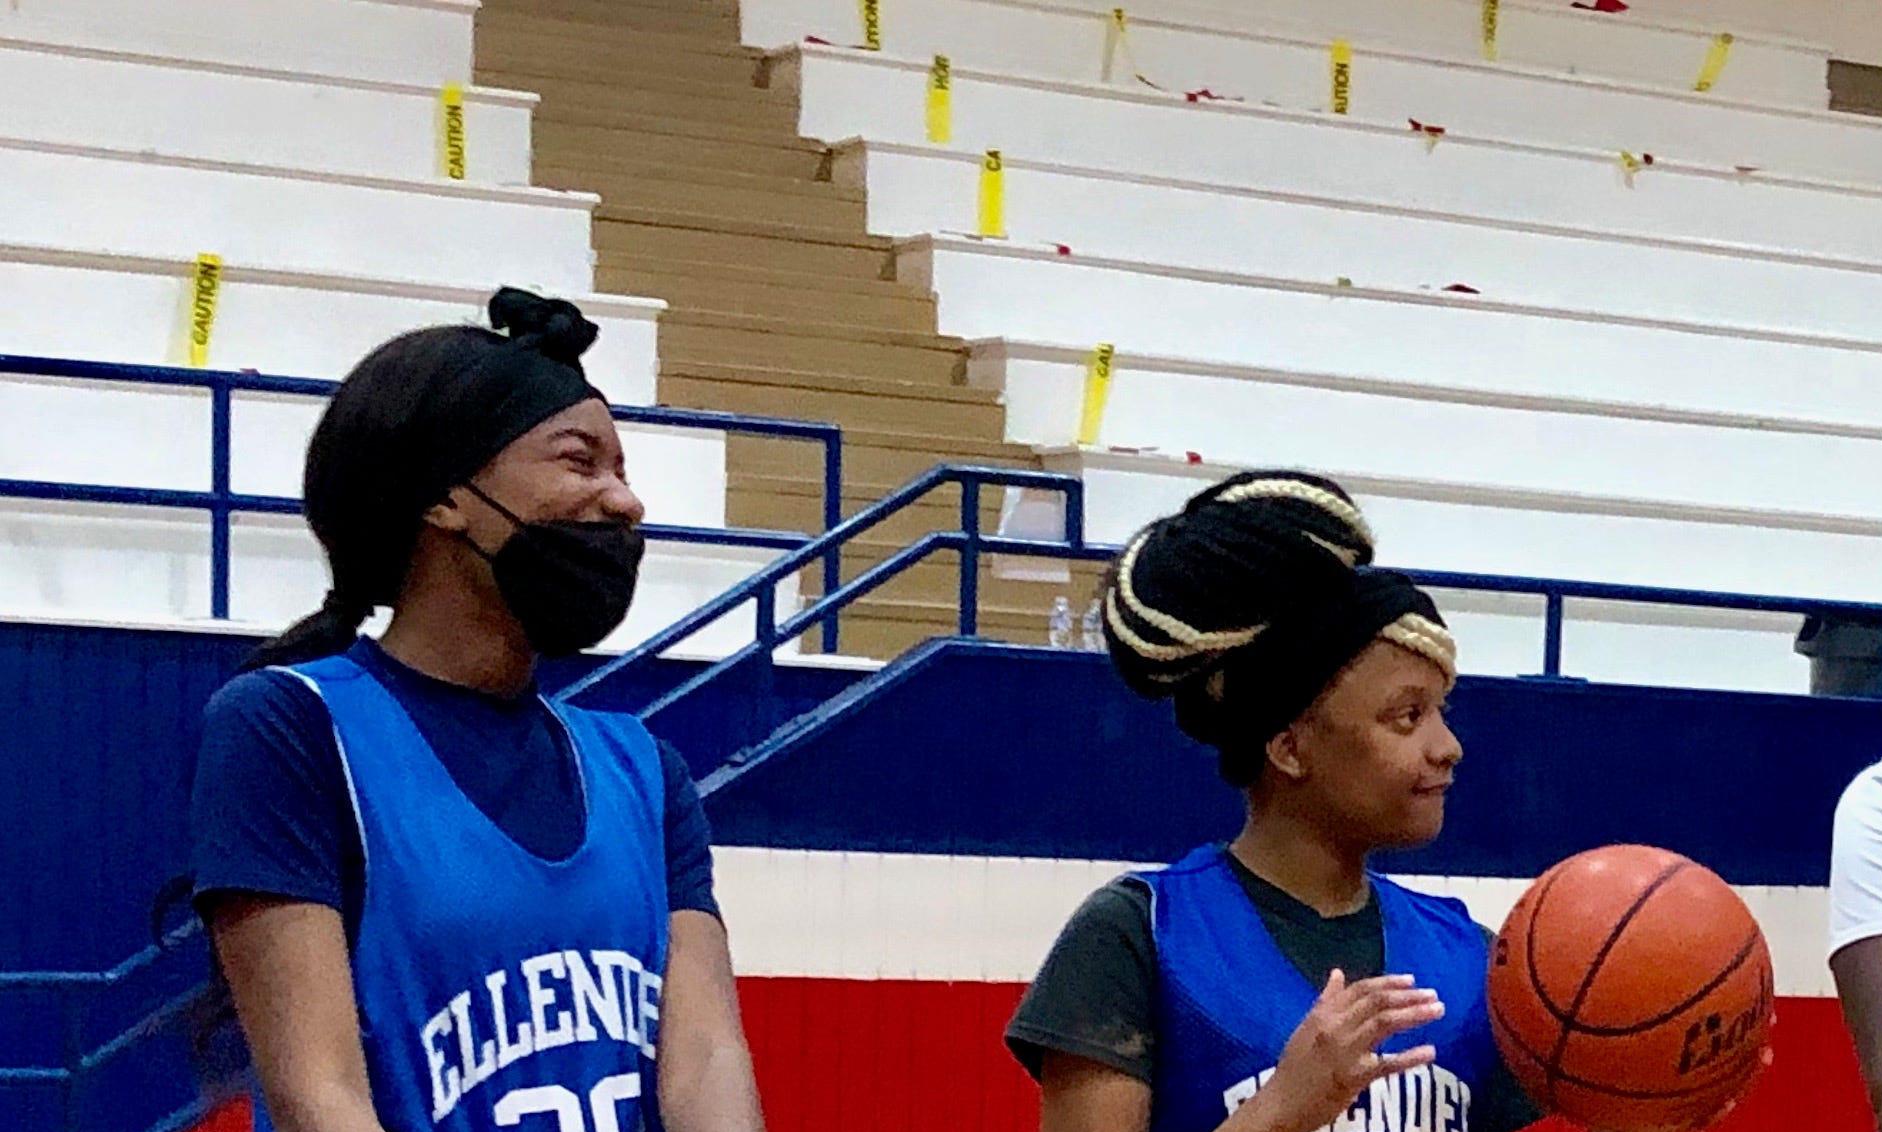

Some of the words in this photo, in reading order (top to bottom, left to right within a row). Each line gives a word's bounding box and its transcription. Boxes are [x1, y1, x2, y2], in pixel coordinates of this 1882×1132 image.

[446, 104, 464, 180] CAUTION
[193, 261, 218, 346] CAUTION
[421, 950, 662, 1123] ELLENDE
